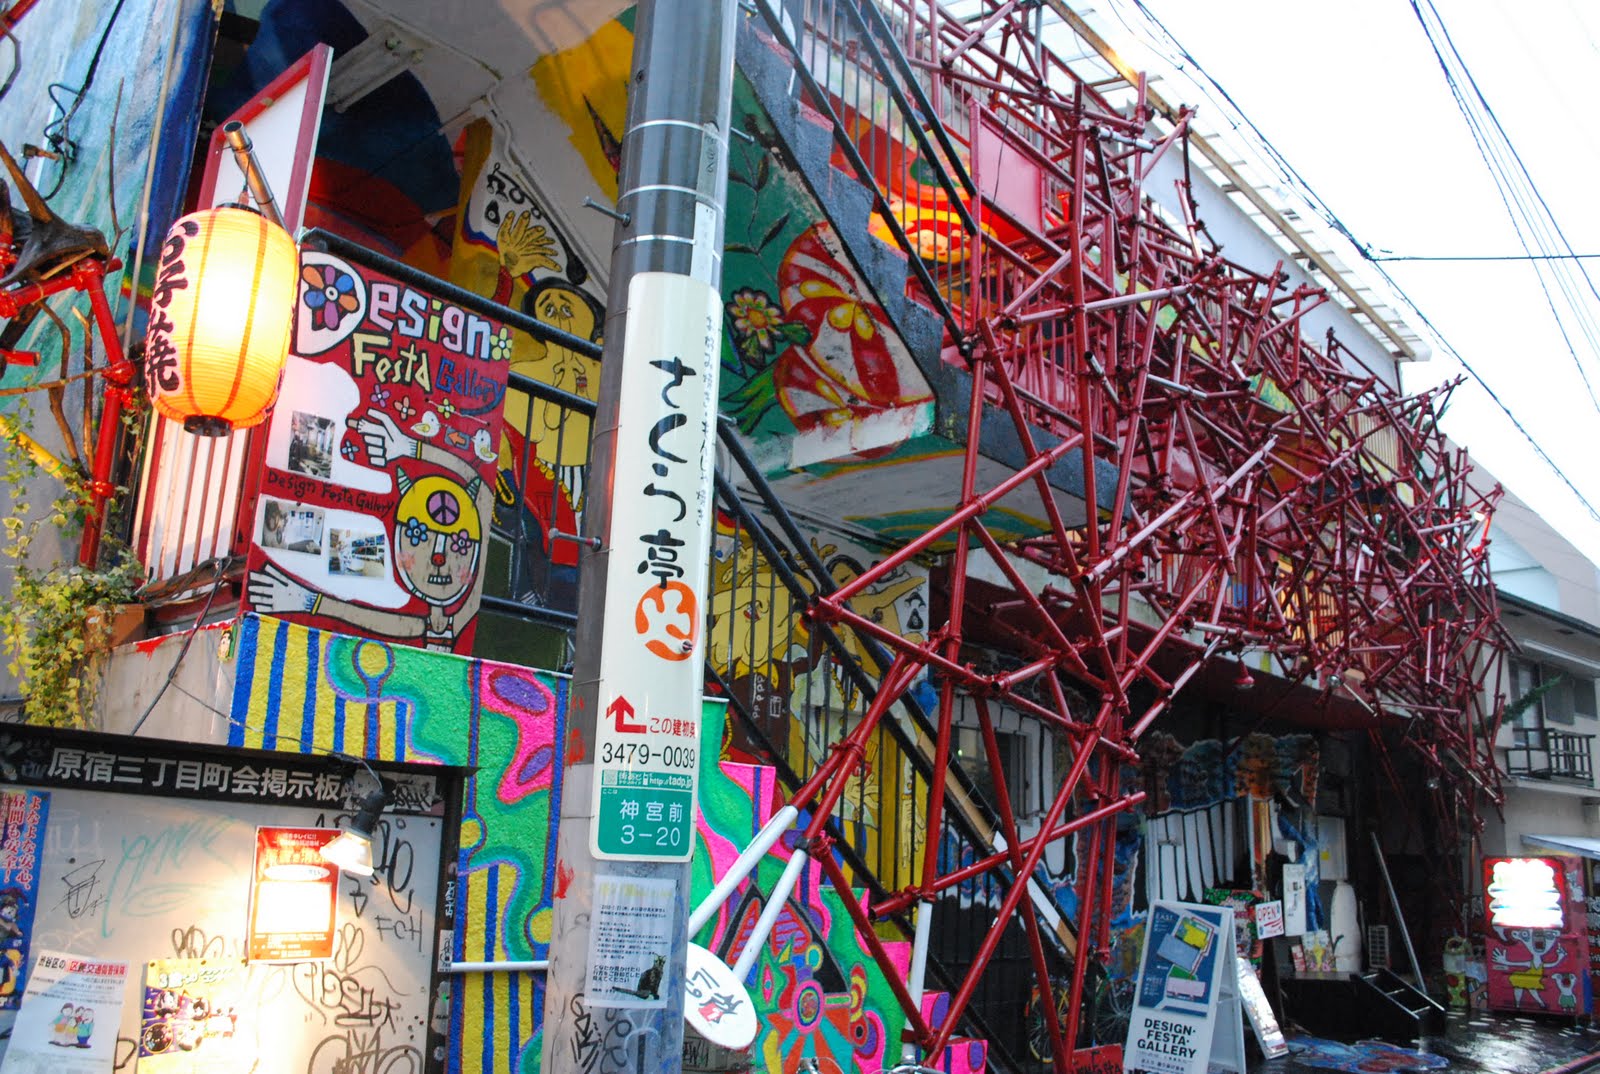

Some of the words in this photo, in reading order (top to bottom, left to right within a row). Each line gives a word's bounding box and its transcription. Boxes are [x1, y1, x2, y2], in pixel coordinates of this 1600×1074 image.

[352, 332, 433, 394] Festa
[434, 356, 507, 417] Gallery
[268, 470, 316, 497] Design
[322, 481, 354, 507] Festa
[355, 493, 396, 518] Gallery
[637, 356, 697, 589] さくら亭
[48, 747, 342, 801] 原宿三丁目町会掲示板
[602, 742, 696, 768] 3479-0039
[620, 799, 683, 823] 神宮前
[620, 825, 681, 847] 3-20
[1137, 1038, 1197, 1059] GALLERY
